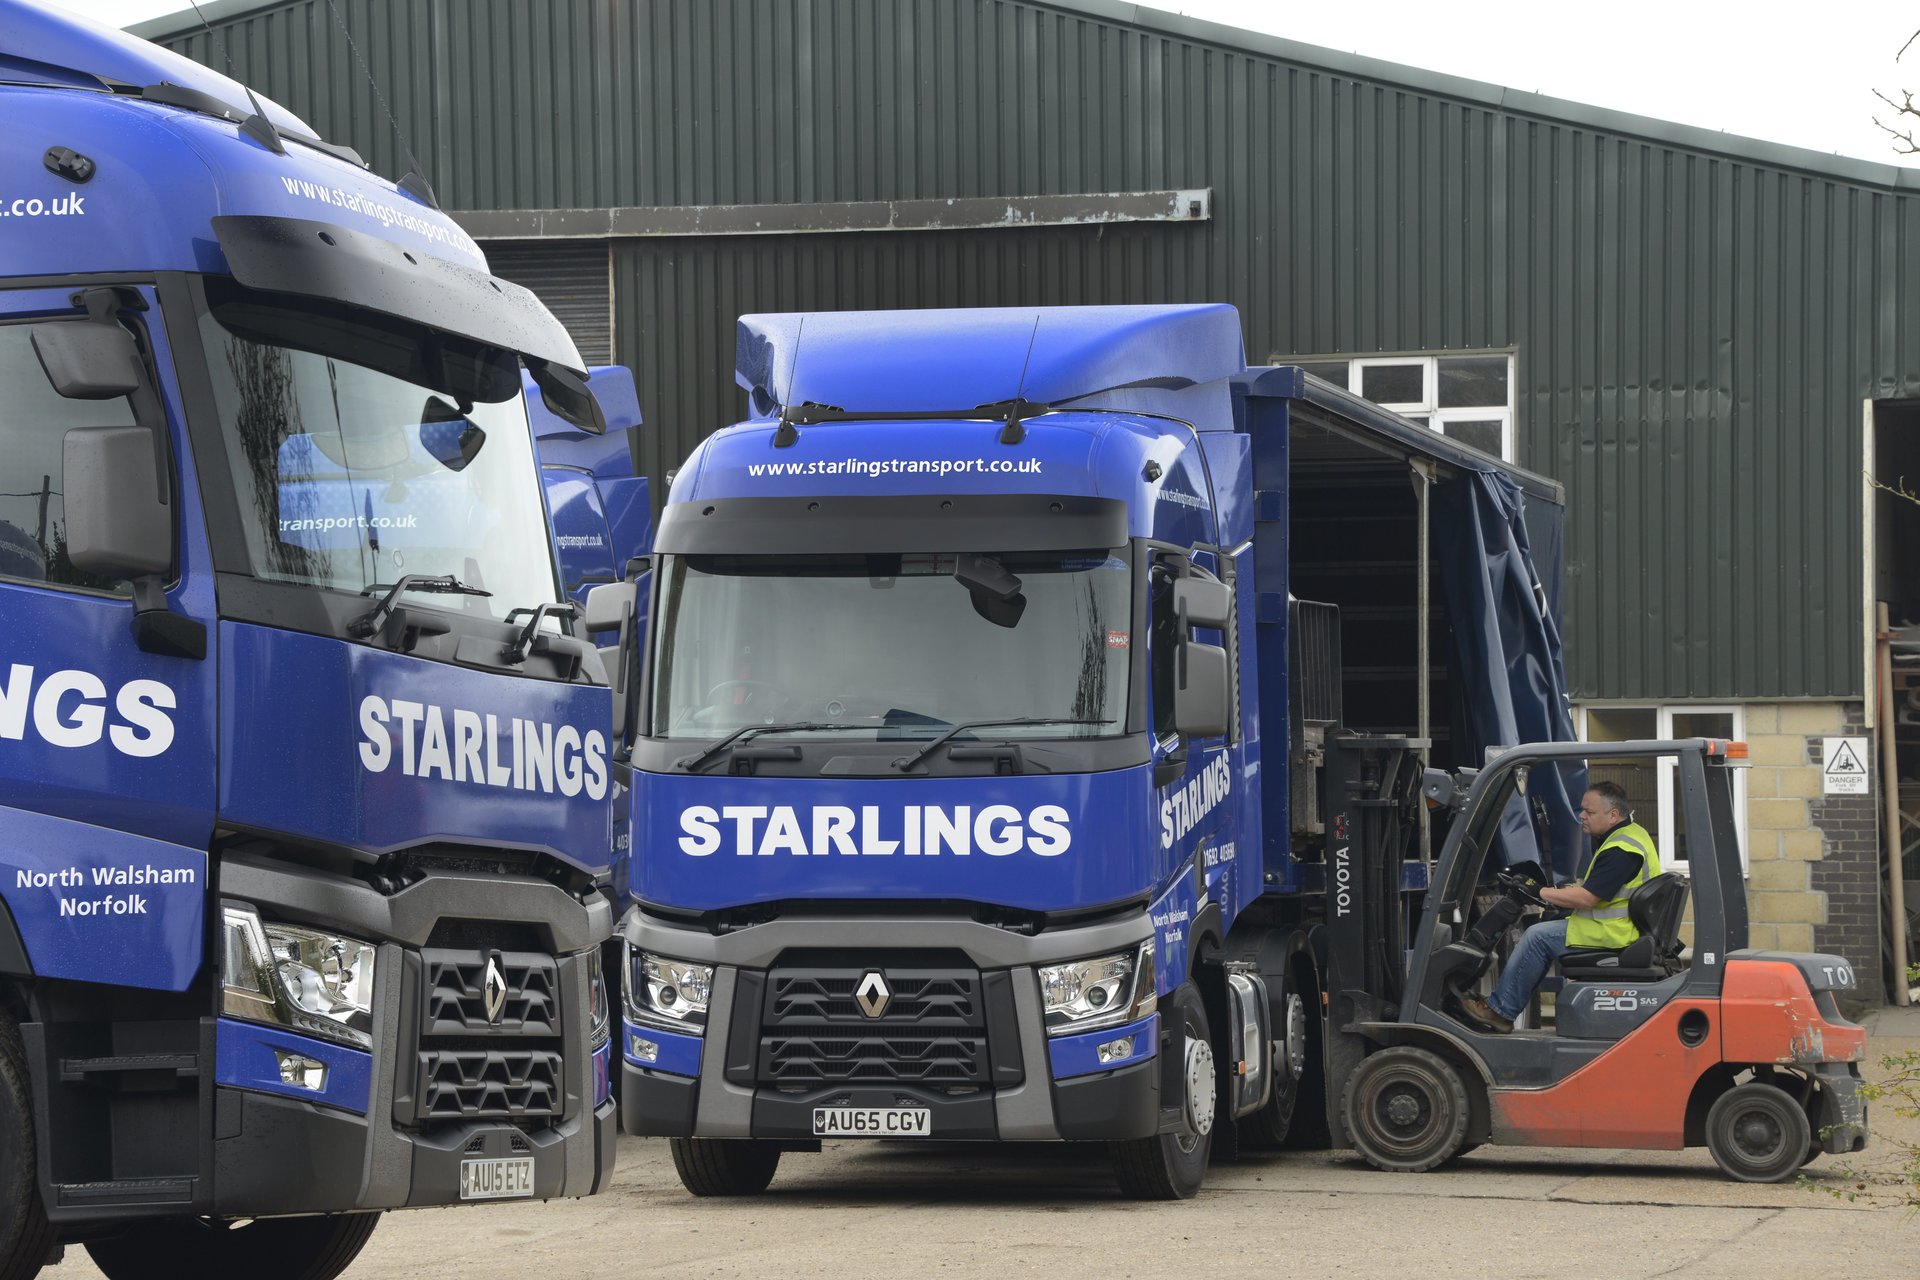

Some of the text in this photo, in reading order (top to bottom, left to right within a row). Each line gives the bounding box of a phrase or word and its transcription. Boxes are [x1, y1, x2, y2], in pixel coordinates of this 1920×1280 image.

[748, 457, 1042, 478] www.starlingstransport.co.uk
[358, 694, 608, 801] STARLINGS
[1829, 776, 1863, 784] DANGER
[1160, 748, 1231, 850] STARLINGS
[678, 804, 1072, 857] STARLINGS
[16, 865, 195, 888] North Walsham
[1336, 846, 1351, 917] TOYOTA
[60, 894, 147, 917] Norfolk
[1153, 912, 1170, 928] North
[1165, 928, 1183, 944] Norfolk
[1593, 997, 1638, 1011] 20
[827, 1111, 926, 1131] AU65 CGV
[473, 1161, 530, 1193] AU15 ETZ
